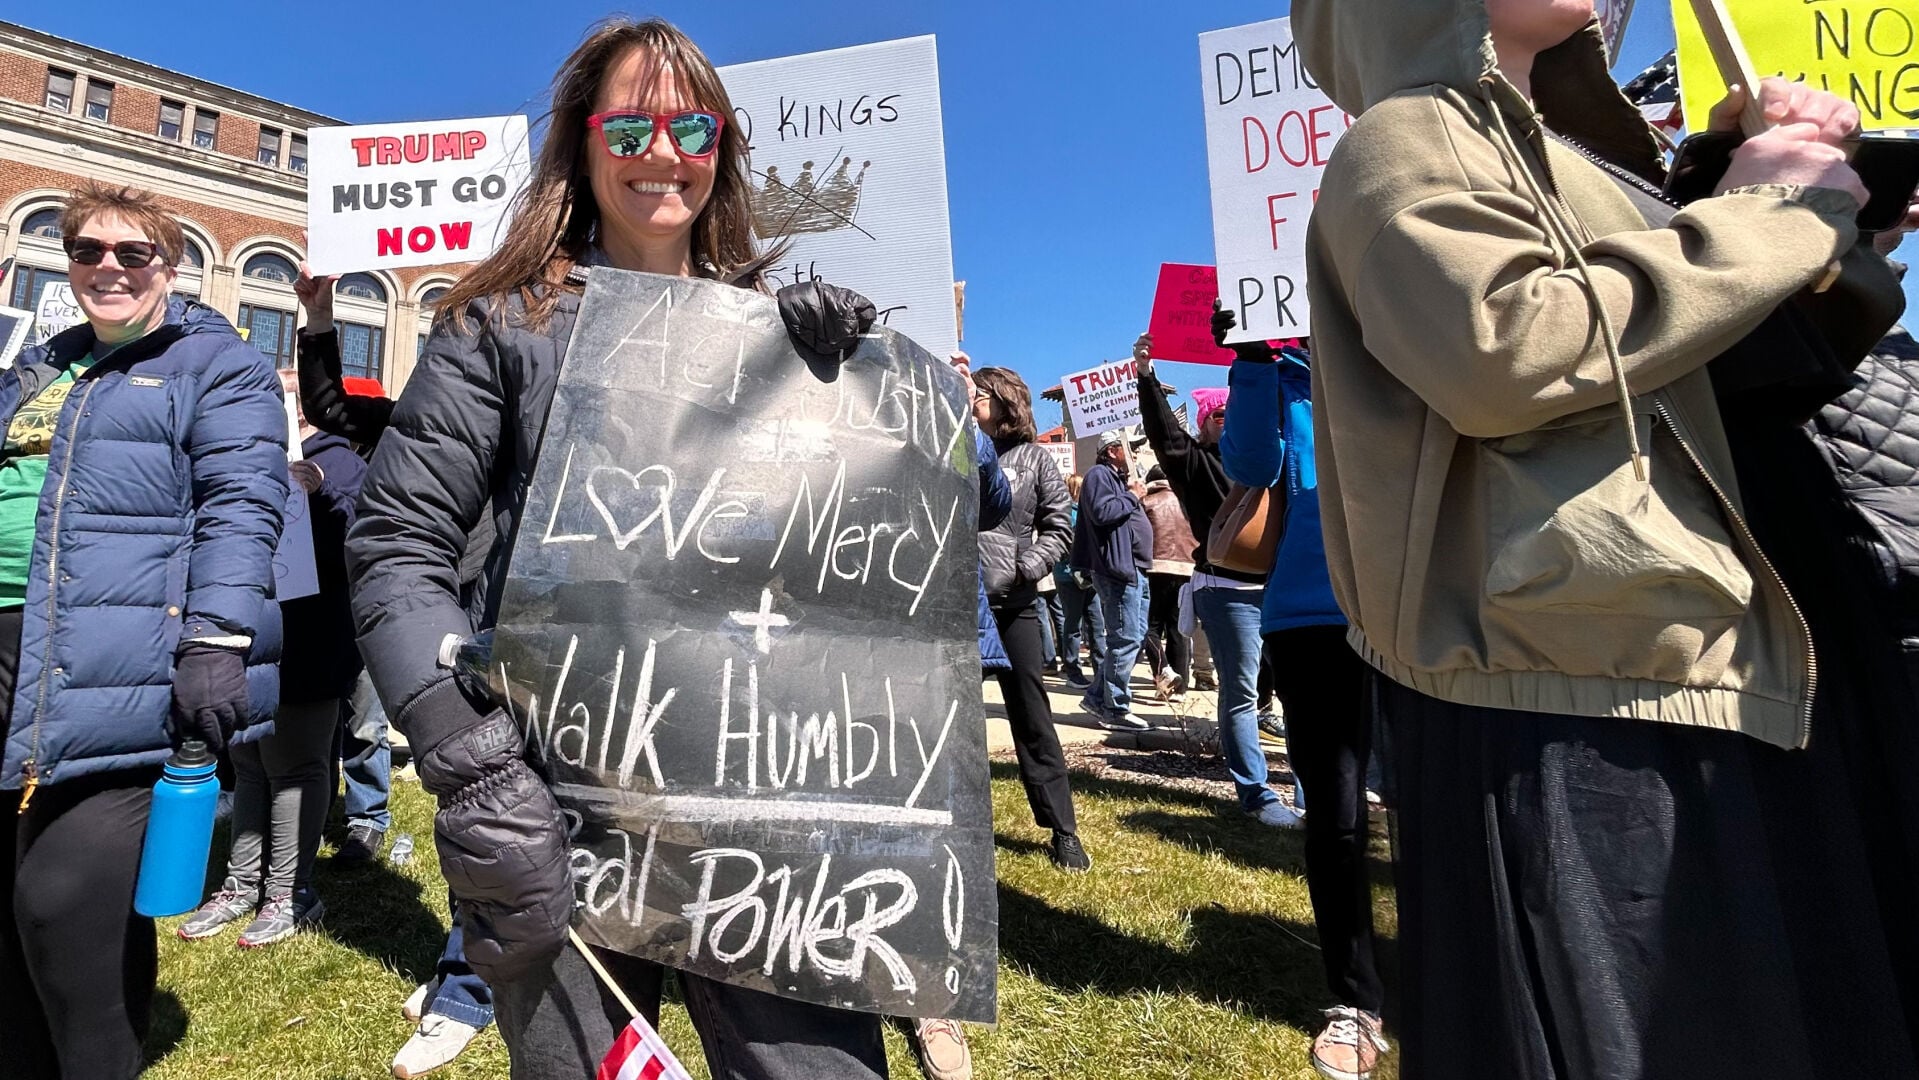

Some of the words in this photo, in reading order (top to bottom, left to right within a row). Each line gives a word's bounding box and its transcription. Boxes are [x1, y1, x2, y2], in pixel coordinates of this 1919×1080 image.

[1814, 7, 1914, 60] NO
[1215, 40, 1320, 105] DEM
[777, 93, 902, 142] KINGS
[1242, 104, 1352, 174] DOE
[351, 130, 487, 167] TRUMP
[332, 179, 437, 213] MUST
[452, 174, 507, 203] GO
[377, 221, 473, 257] NOW
[42, 299, 80, 318] EVER
[1238, 274, 1298, 331] PR
[1081, 403, 1102, 415] WAR
[1096, 413, 1121, 426] STILL
[1123, 407, 1140, 419] SUC
[769, 457, 959, 617] Mercy
[499, 633, 678, 790] Walk
